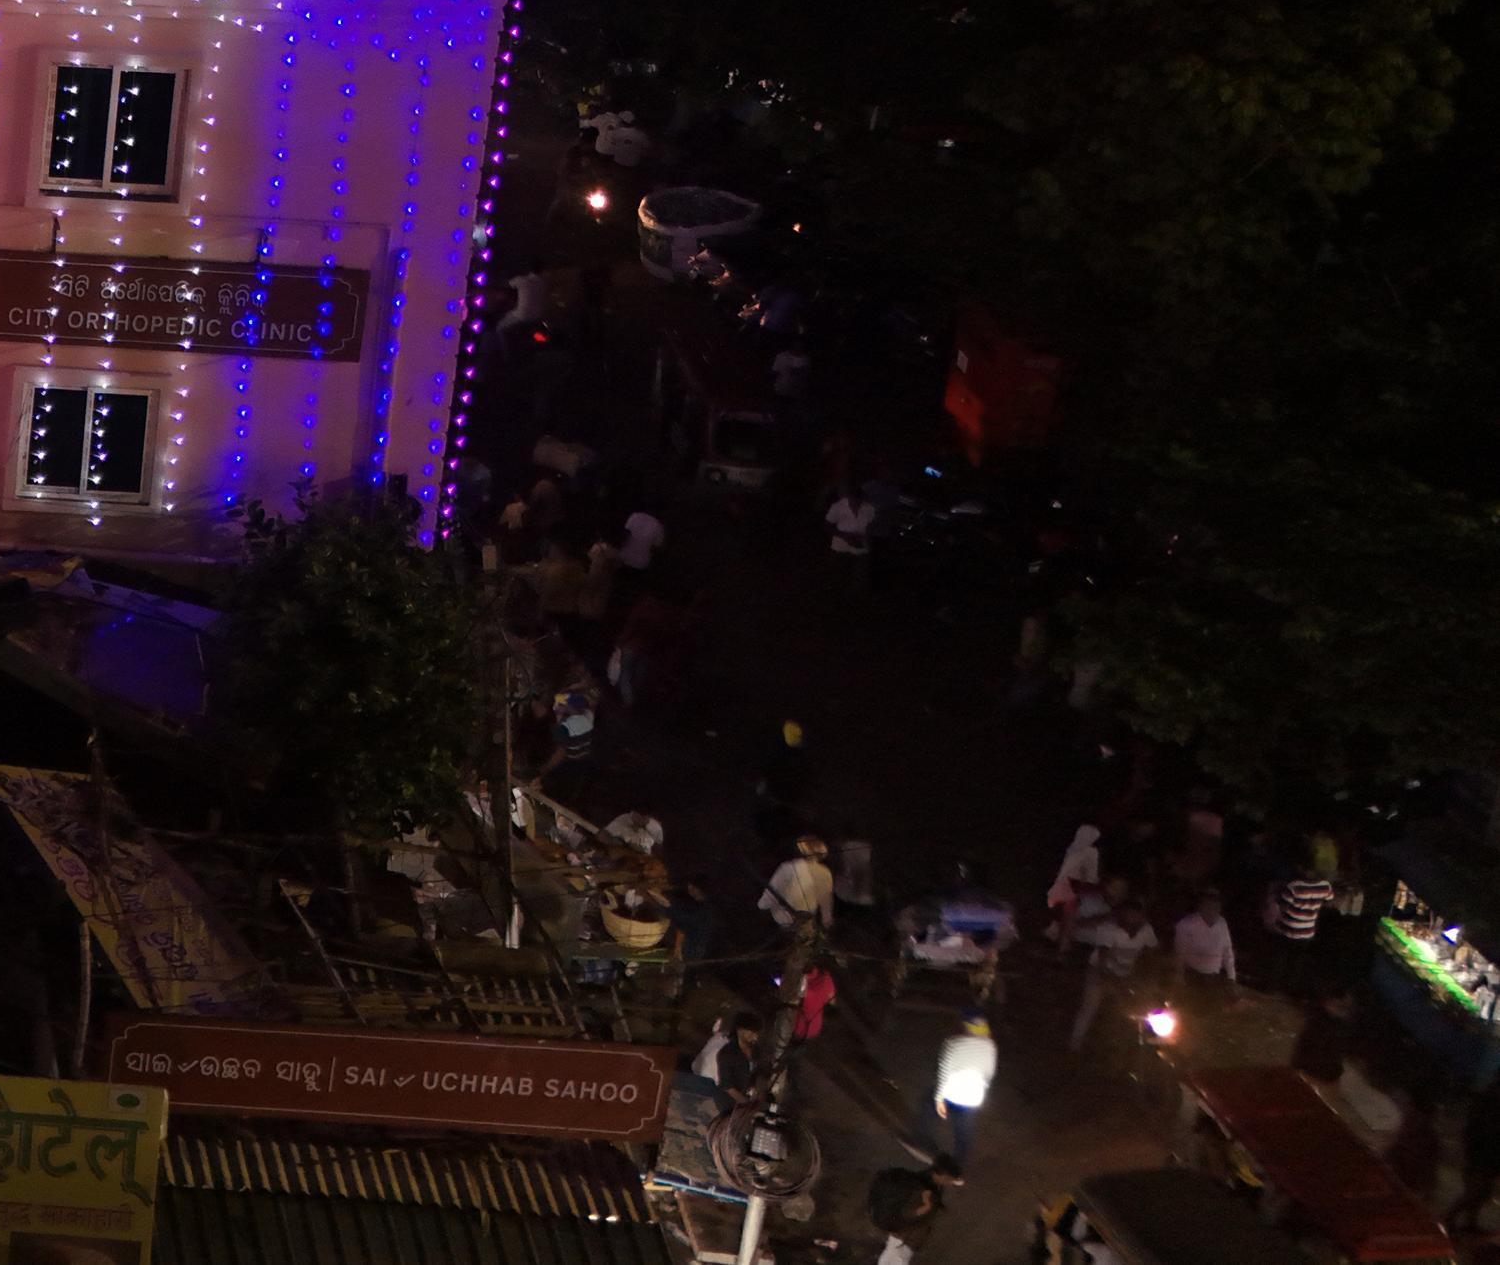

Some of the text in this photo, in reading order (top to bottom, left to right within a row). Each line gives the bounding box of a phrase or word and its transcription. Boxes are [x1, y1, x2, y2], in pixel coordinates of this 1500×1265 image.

[8, 307, 312, 342] CITY ORTHOPEDIC CINIC
[344, 1065, 640, 1105] SAI UCHHAB SAHOO
